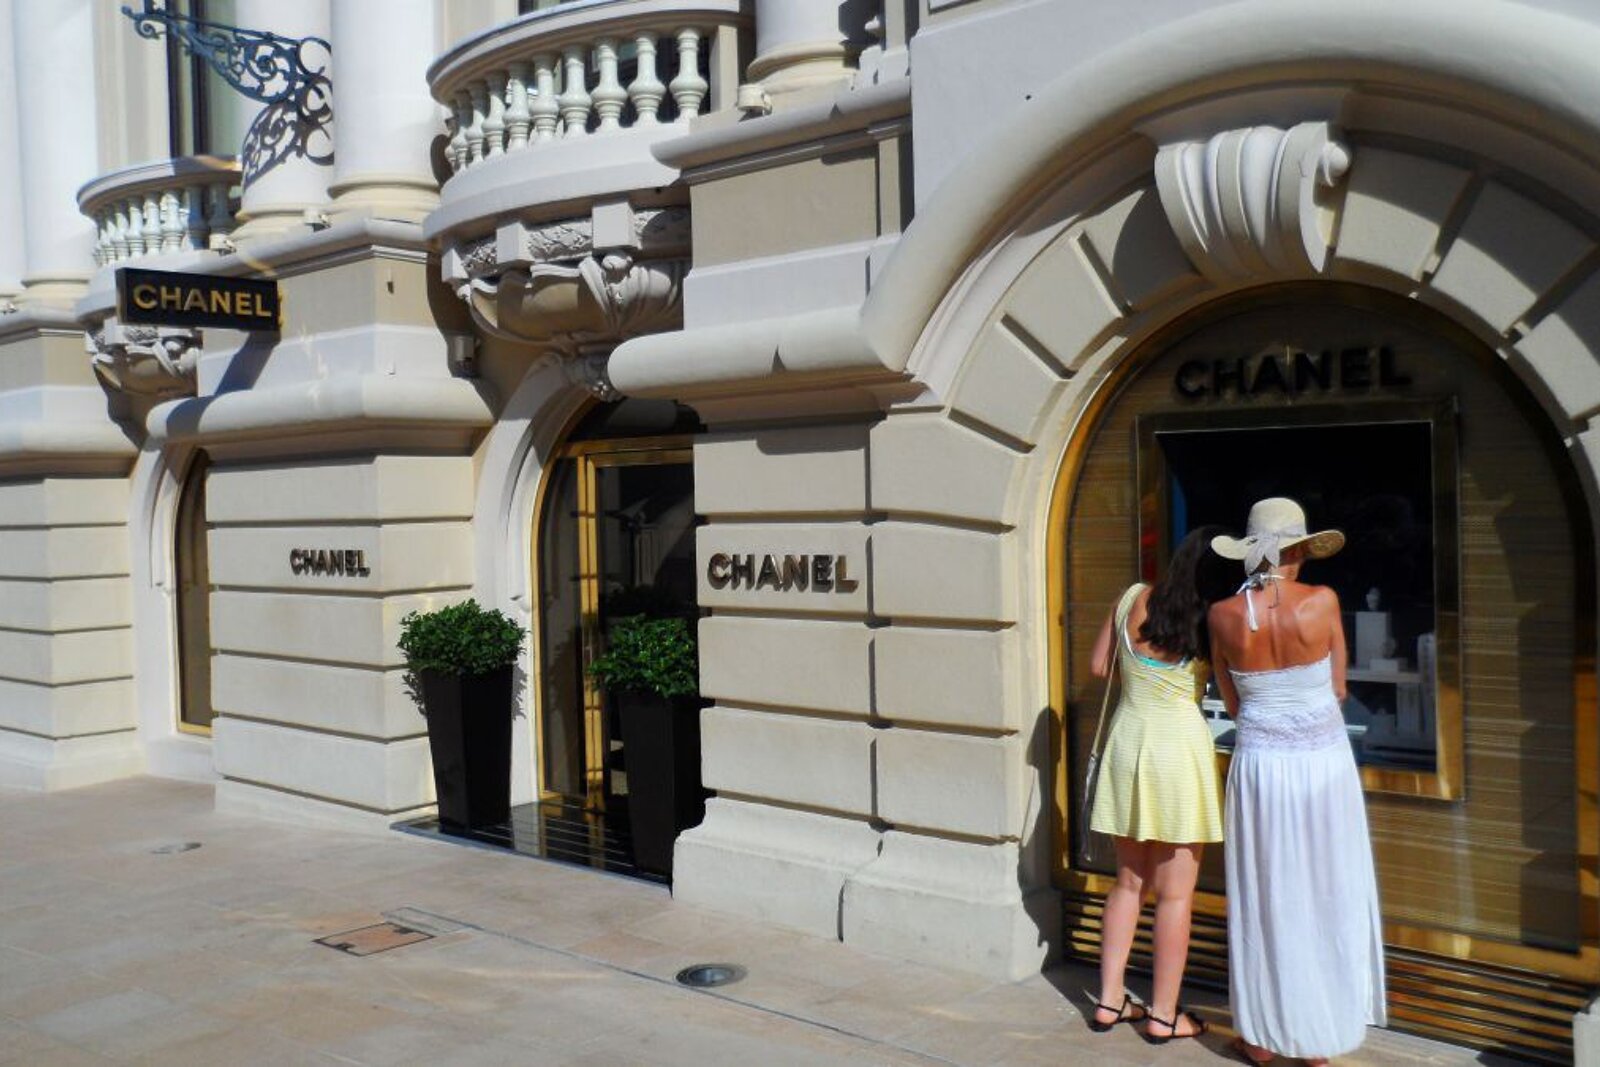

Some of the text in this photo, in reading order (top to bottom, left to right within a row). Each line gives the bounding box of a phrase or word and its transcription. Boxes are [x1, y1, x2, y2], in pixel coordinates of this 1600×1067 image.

[133, 284, 272, 317] CHANEL
[1175, 346, 1412, 398] CHANEL
[290, 548, 370, 577] CHANEL
[707, 553, 859, 593] CHANEL
